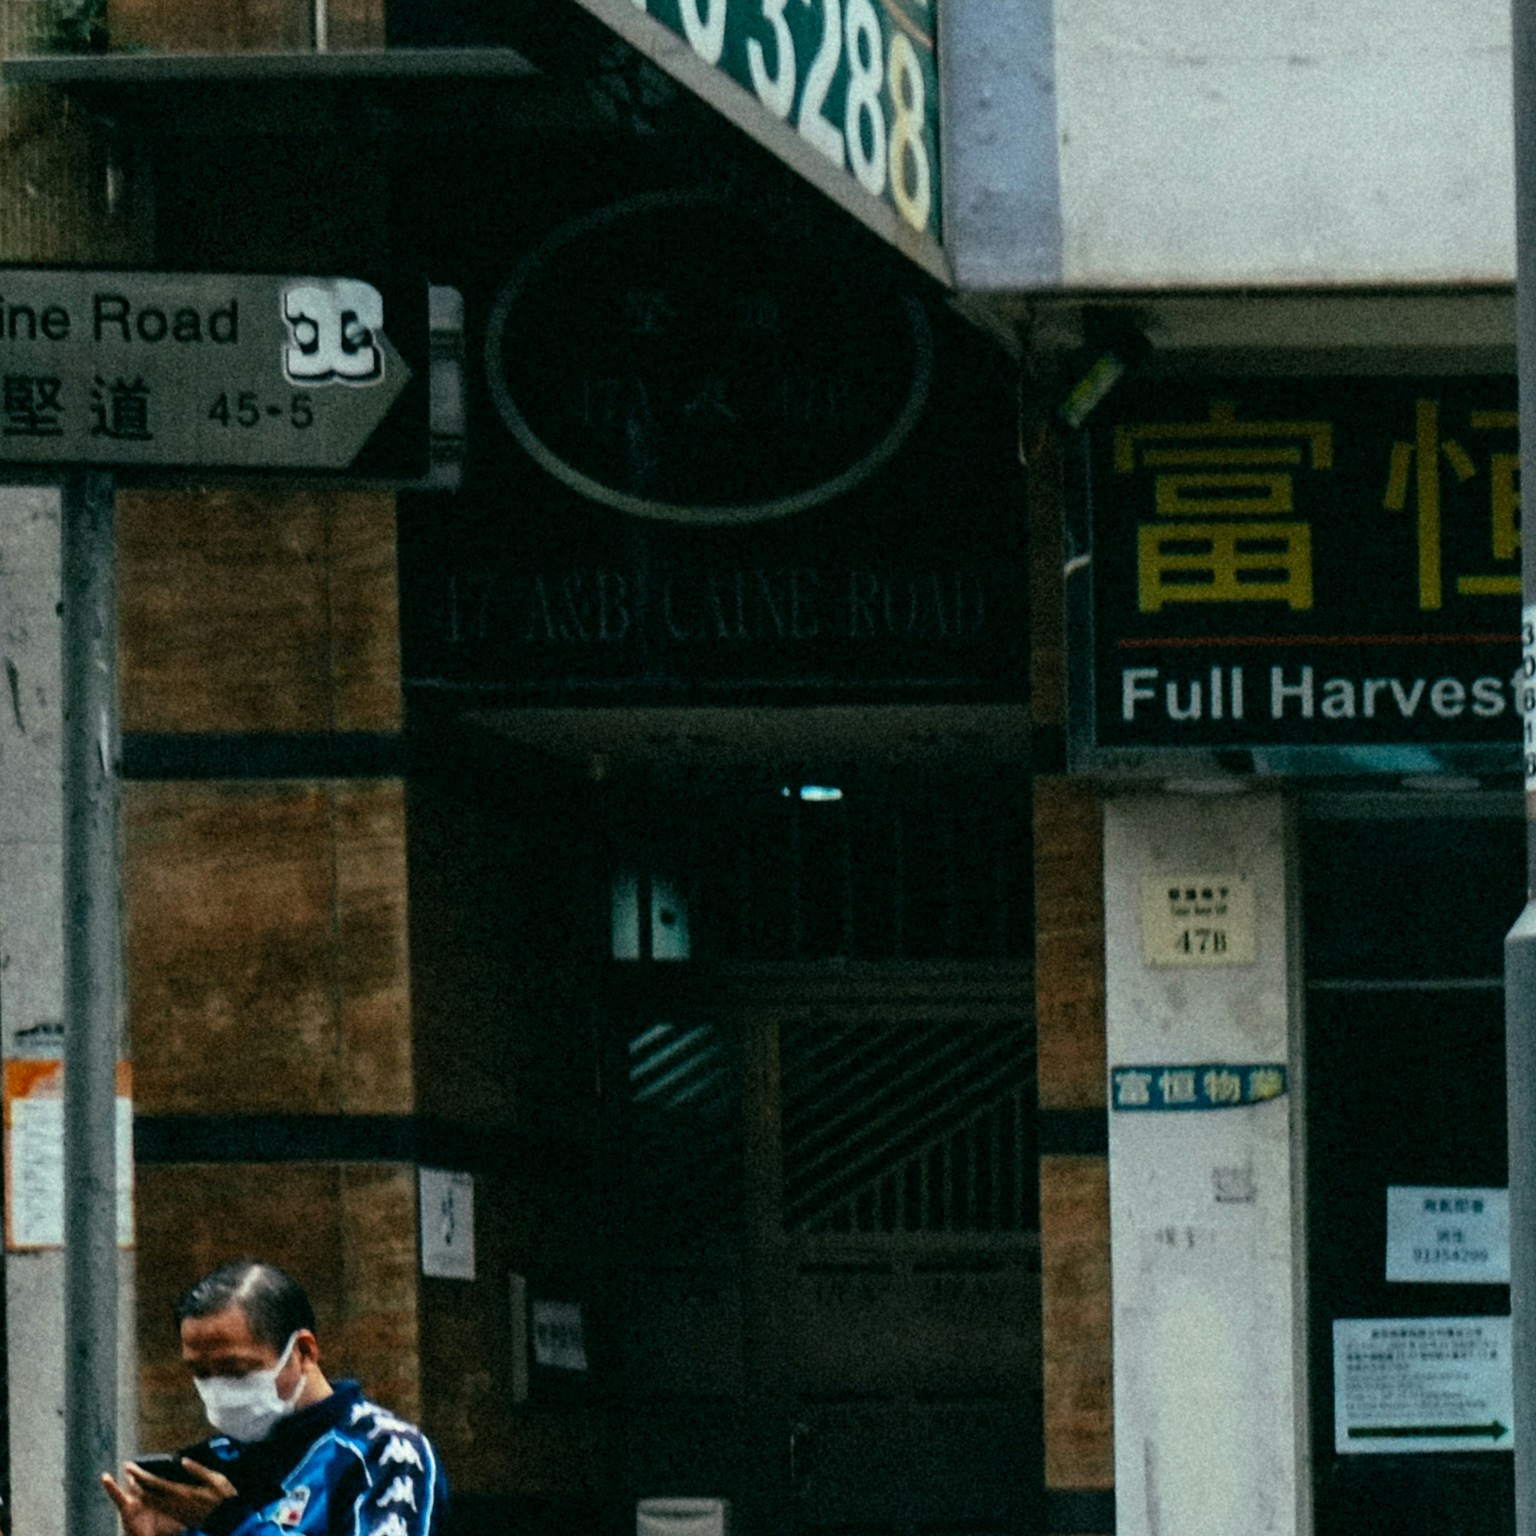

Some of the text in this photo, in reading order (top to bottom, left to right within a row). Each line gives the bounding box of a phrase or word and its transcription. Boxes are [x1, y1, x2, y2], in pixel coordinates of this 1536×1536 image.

[92, 293, 239, 344] Road
[206, 391, 314, 430] 45-5
[1121, 666, 1244, 721] Full
[1173, 928, 1228, 955] 47B
